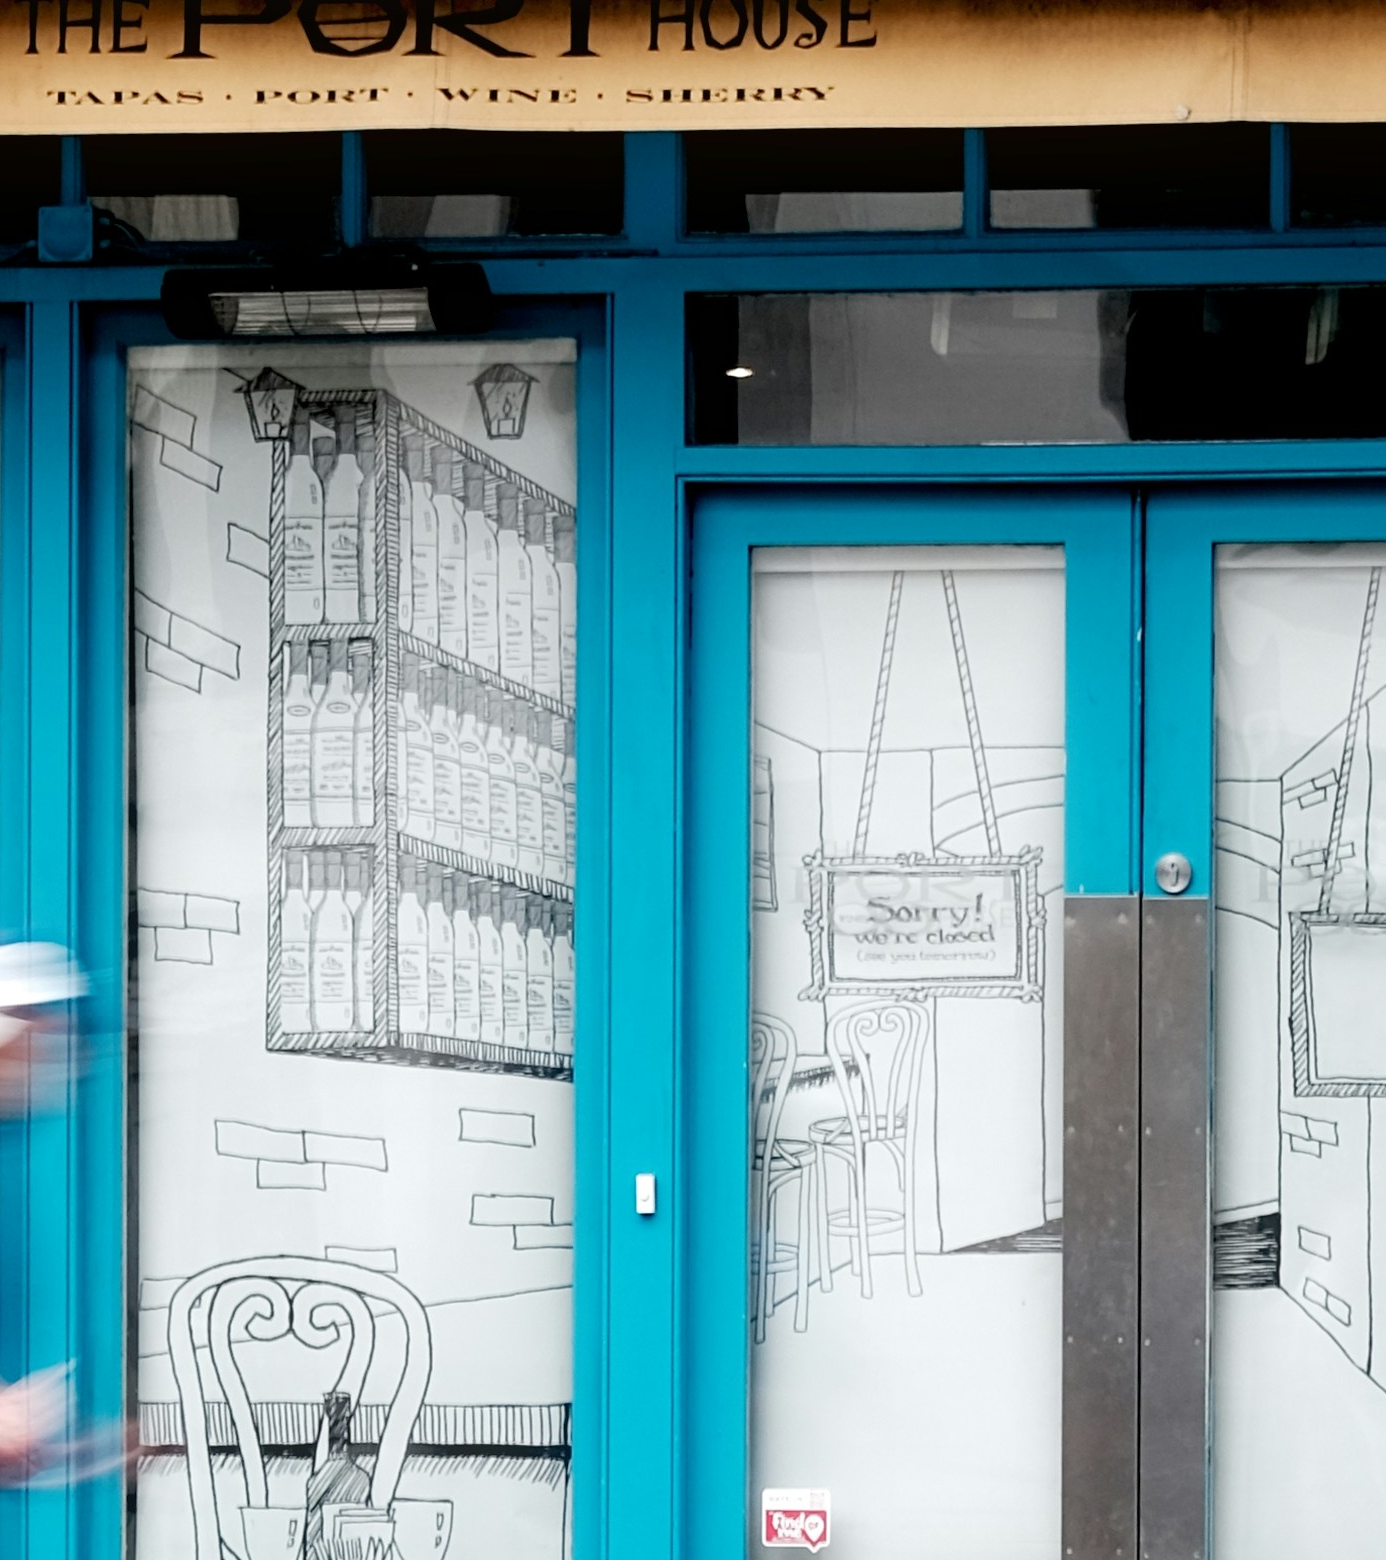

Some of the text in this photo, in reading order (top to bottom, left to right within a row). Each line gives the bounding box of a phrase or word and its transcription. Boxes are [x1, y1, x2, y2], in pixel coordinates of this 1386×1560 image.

[47, 86, 836, 105] TAPAS PORT WINE SHERRY
[868, 893, 983, 927] Sorry!
[926, 925, 995, 945] closed
